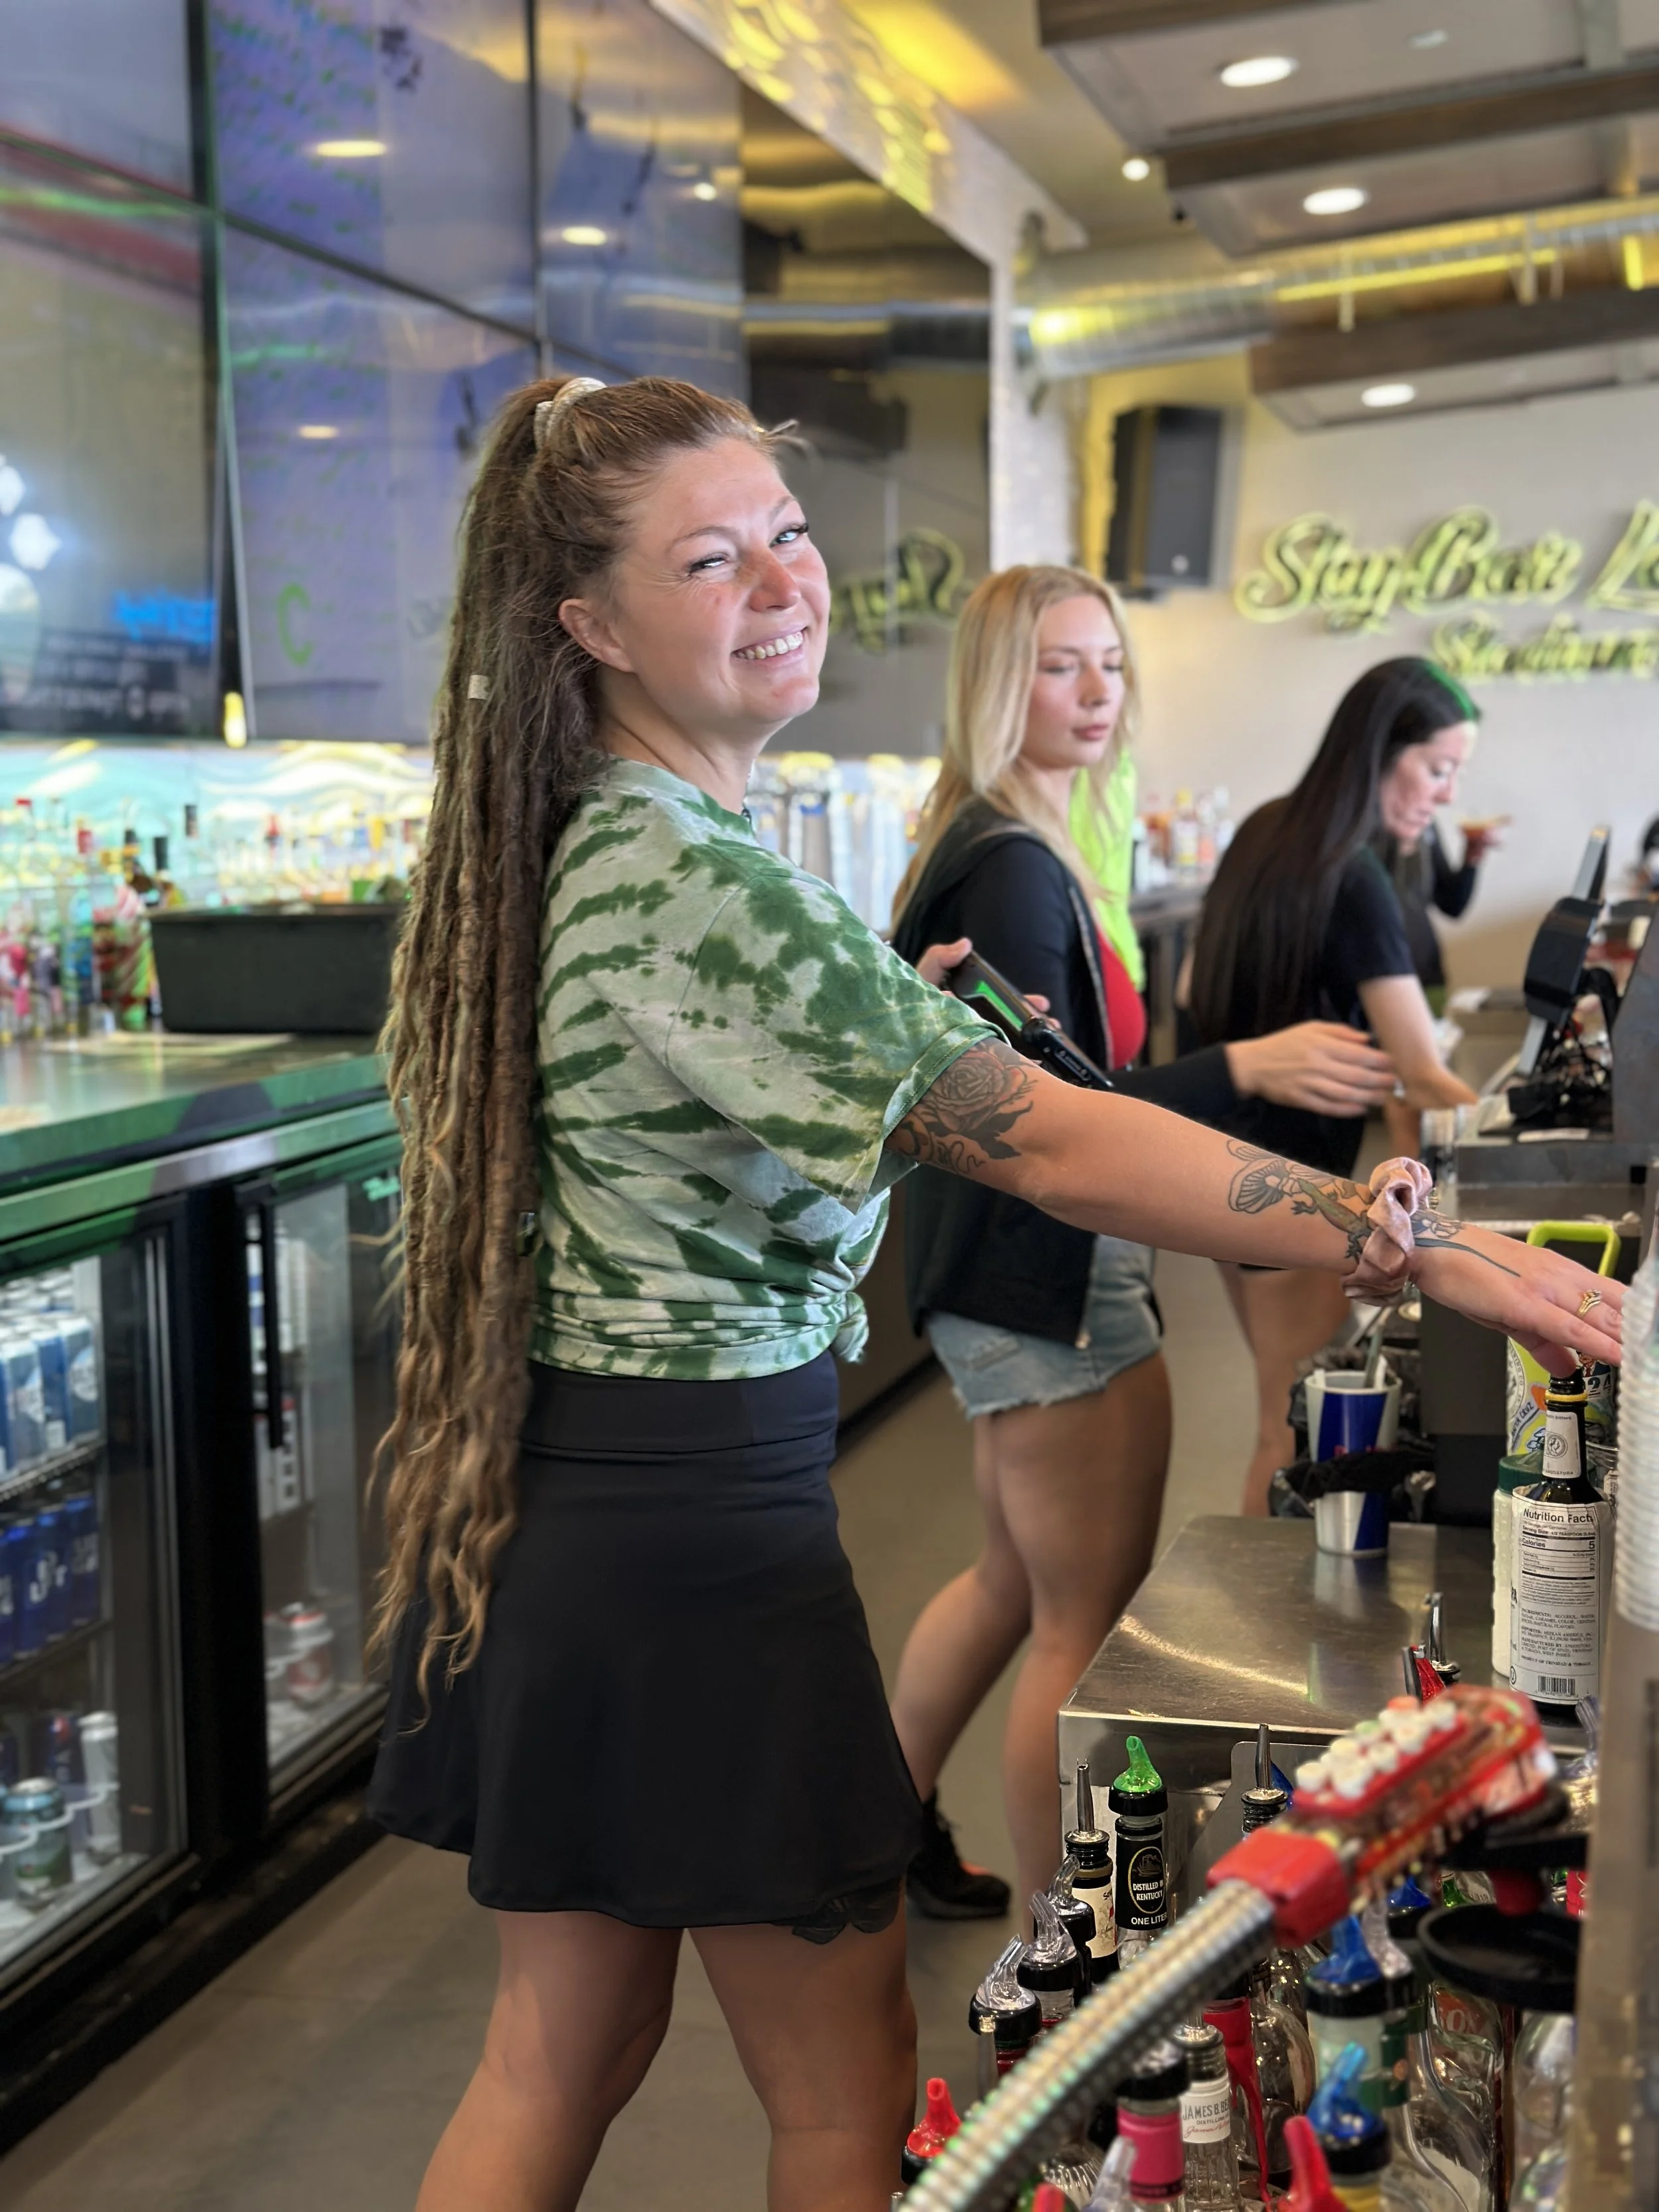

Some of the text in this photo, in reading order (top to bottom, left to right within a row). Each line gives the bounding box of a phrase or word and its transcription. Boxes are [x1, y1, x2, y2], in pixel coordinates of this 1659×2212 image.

[1520, 1402, 1534, 1419] CRUZ
[1523, 1508, 1564, 1522] Nutrition
[1522, 1538, 1546, 1548] Calories
[1589, 1540, 1595, 1550] 5
[1133, 1881, 1159, 1891] DISTILLED
[1136, 1889, 1163, 1901] KENTUCKY
[1131, 1911, 1167, 1925] ONE LITER
[1183, 2104, 1213, 2120] JAMES
[1221, 2099, 1230, 2113] BE
